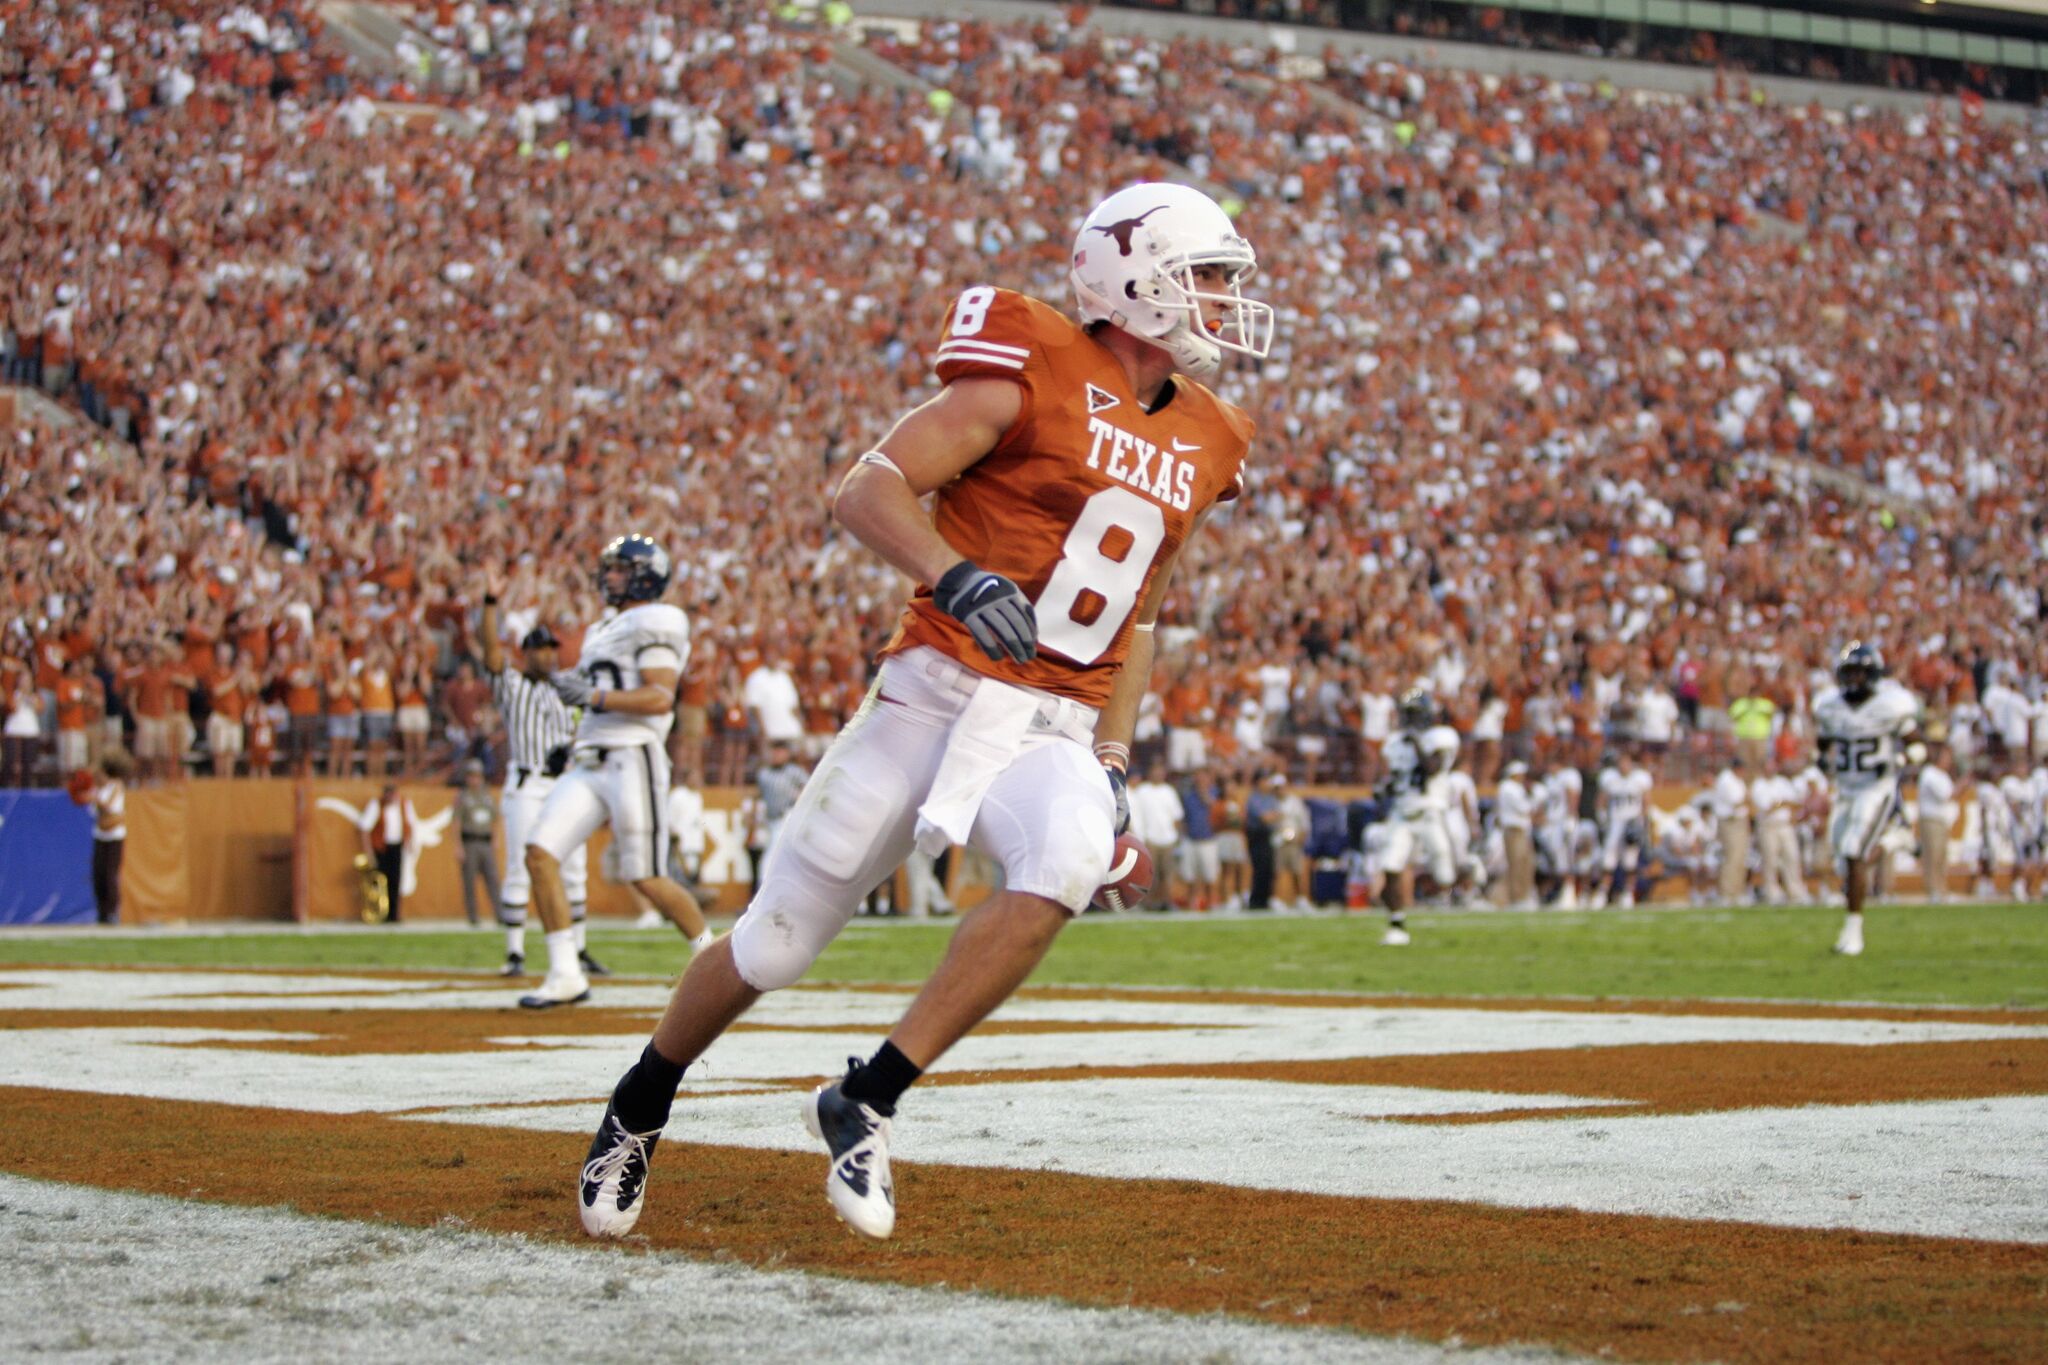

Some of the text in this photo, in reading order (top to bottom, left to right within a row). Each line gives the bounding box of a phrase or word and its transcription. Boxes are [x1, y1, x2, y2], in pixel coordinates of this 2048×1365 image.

[951, 286, 997, 337] 8
[1086, 416, 1195, 512] TEXAS
[1034, 485, 1166, 665] 8
